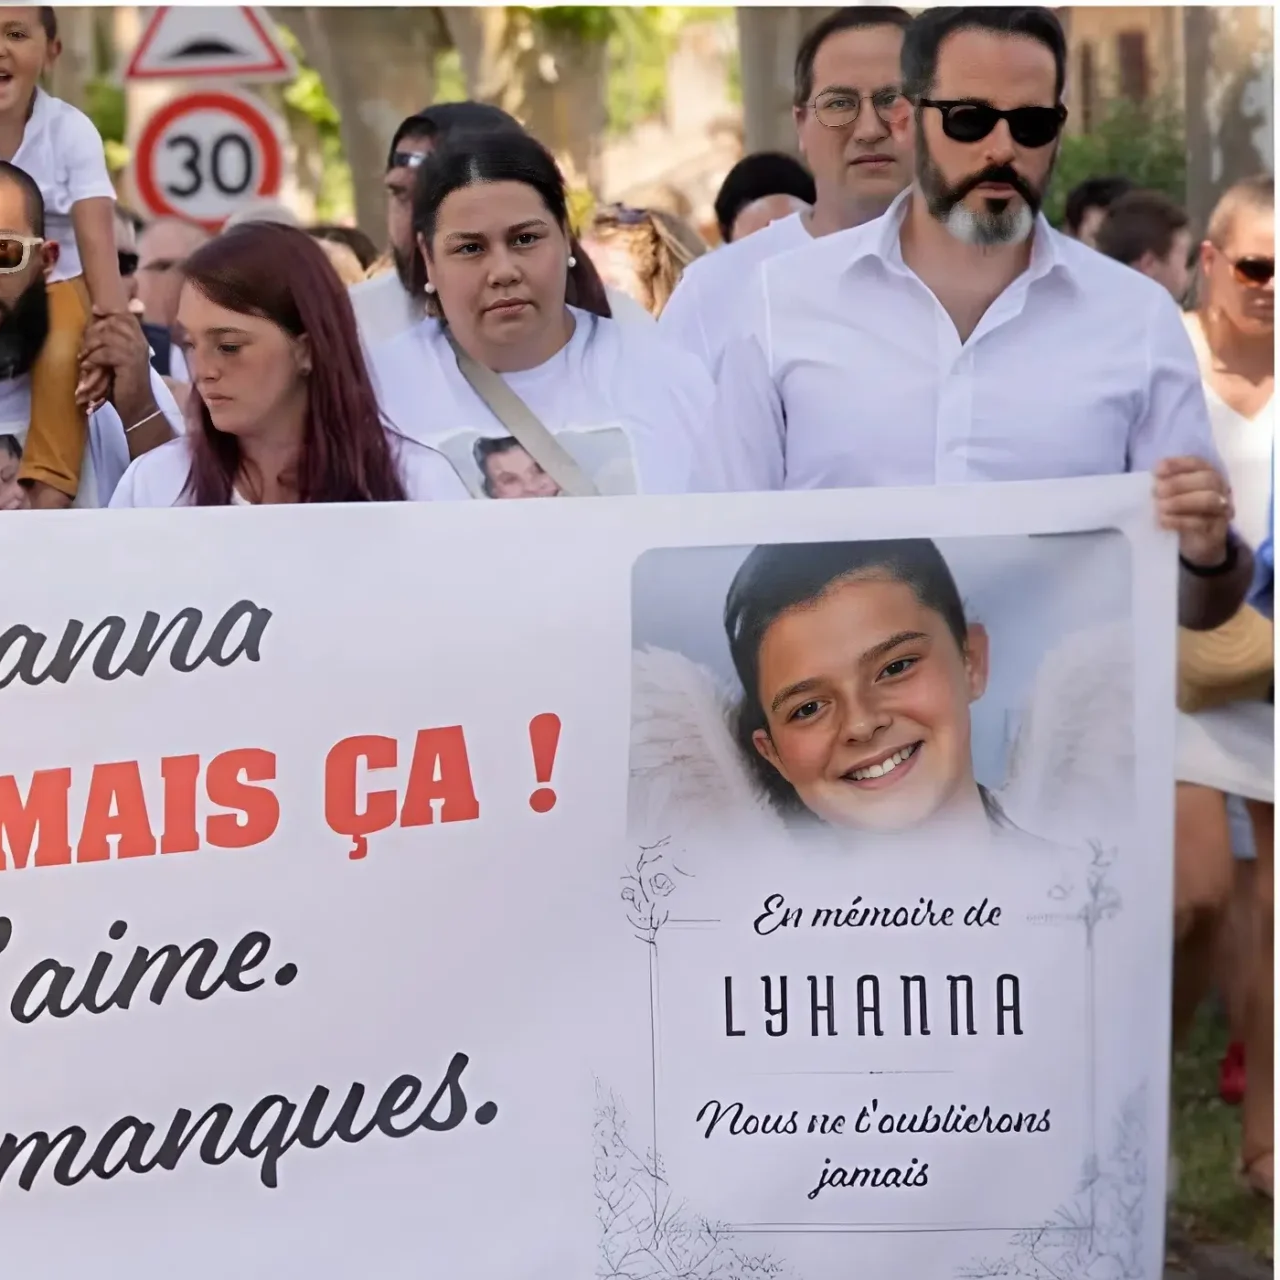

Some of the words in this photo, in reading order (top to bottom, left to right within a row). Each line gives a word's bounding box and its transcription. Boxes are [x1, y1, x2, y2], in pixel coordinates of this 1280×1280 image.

[165, 133, 253, 197] 30
[324, 725, 480, 860] ÇA
[753, 893, 803, 937] En
[810, 896, 955, 928] mémoire
[963, 898, 1002, 928] de
[724, 974, 1024, 1038] LYHANNA
[695, 1099, 799, 1140] Nous
[806, 1114, 846, 1135] ne
[807, 1157, 929, 1201] jamais
